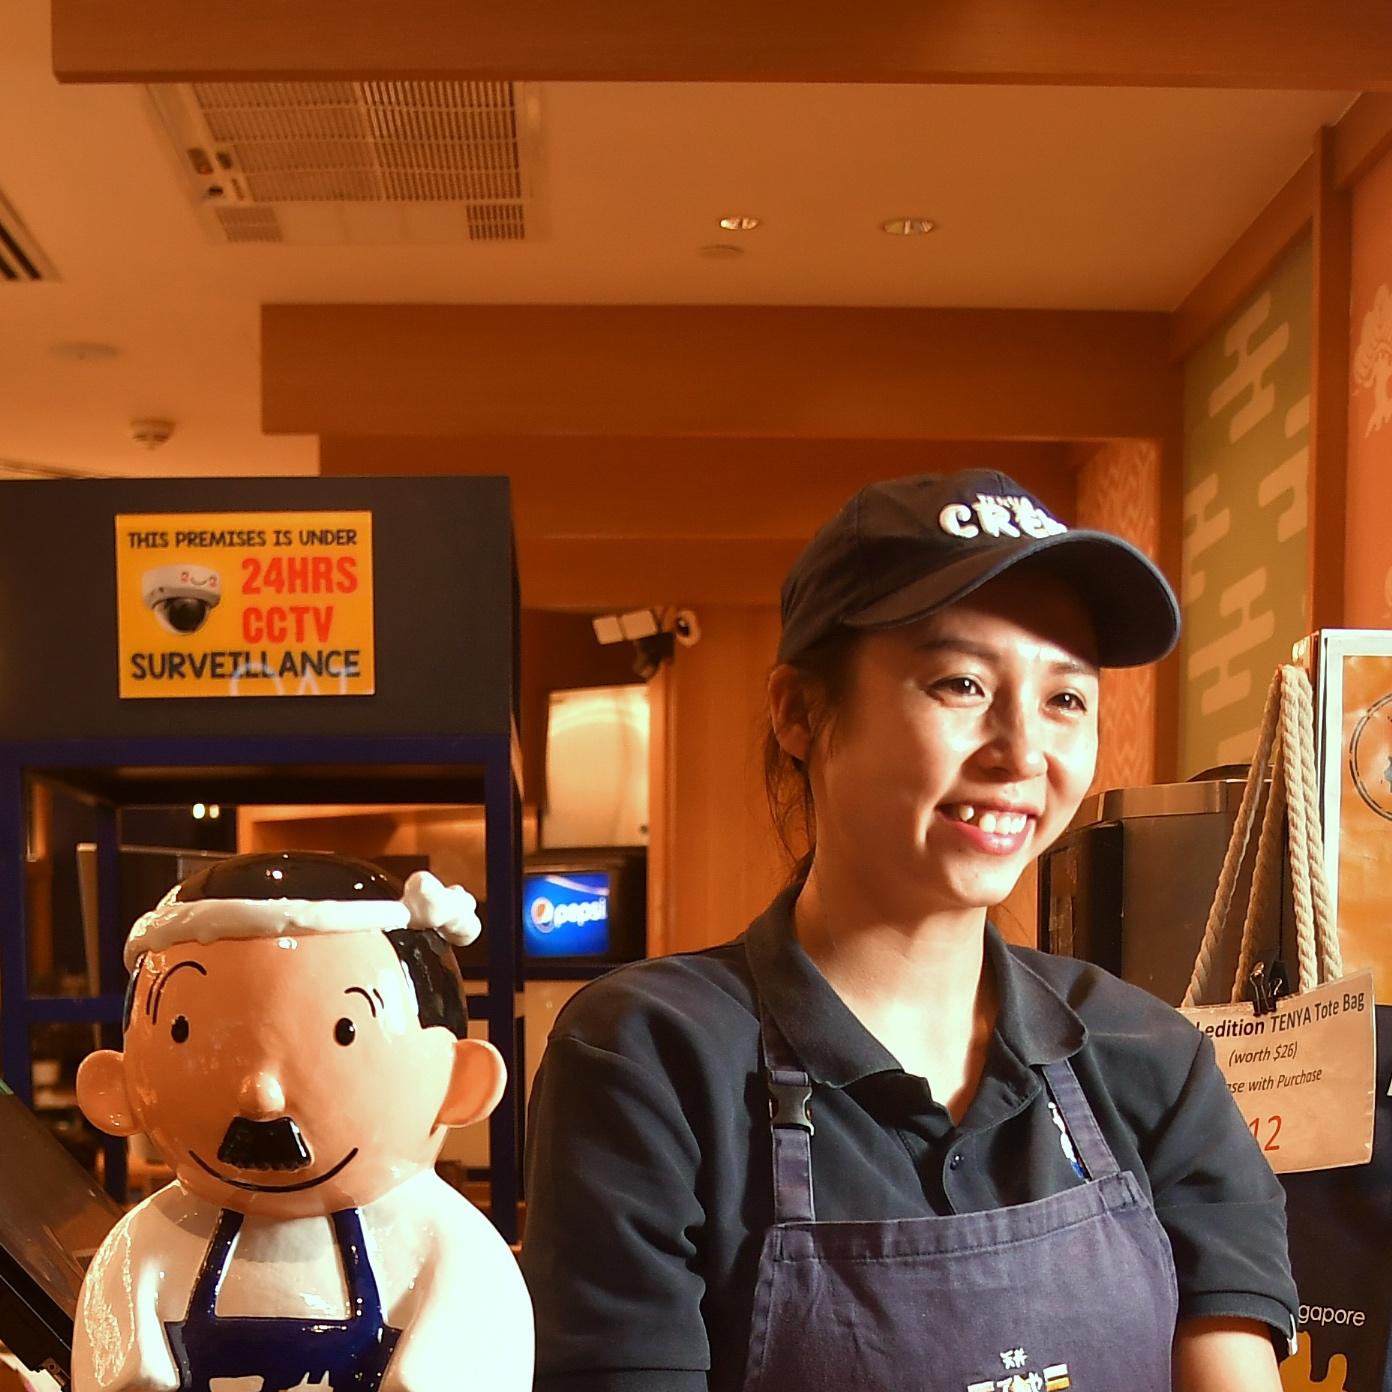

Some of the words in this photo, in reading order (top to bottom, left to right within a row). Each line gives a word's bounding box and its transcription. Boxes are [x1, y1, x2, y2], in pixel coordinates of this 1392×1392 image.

[128, 531, 170, 549] THIS
[175, 530, 267, 549] PREMISES
[273, 530, 293, 548] IS
[299, 528, 357, 547] UNDER
[241, 556, 359, 595] 24HRS
[241, 605, 335, 645] CCTV
[130, 649, 362, 681] SURVEILLANCE
[553, 896, 607, 929] pepsi
[1205, 1019, 1265, 1039] edition
[1270, 1008, 1311, 1034] TENYA
[1314, 1001, 1341, 1023] Tote
[1342, 991, 1365, 1012] Bag
[1228, 1048, 1271, 1067] (worth
[1273, 1041, 1298, 1062] $26)
[1248, 1074, 1274, 1092] with
[1277, 1067, 1323, 1089] Purchase
[1298, 1303, 1366, 1327] gapore
